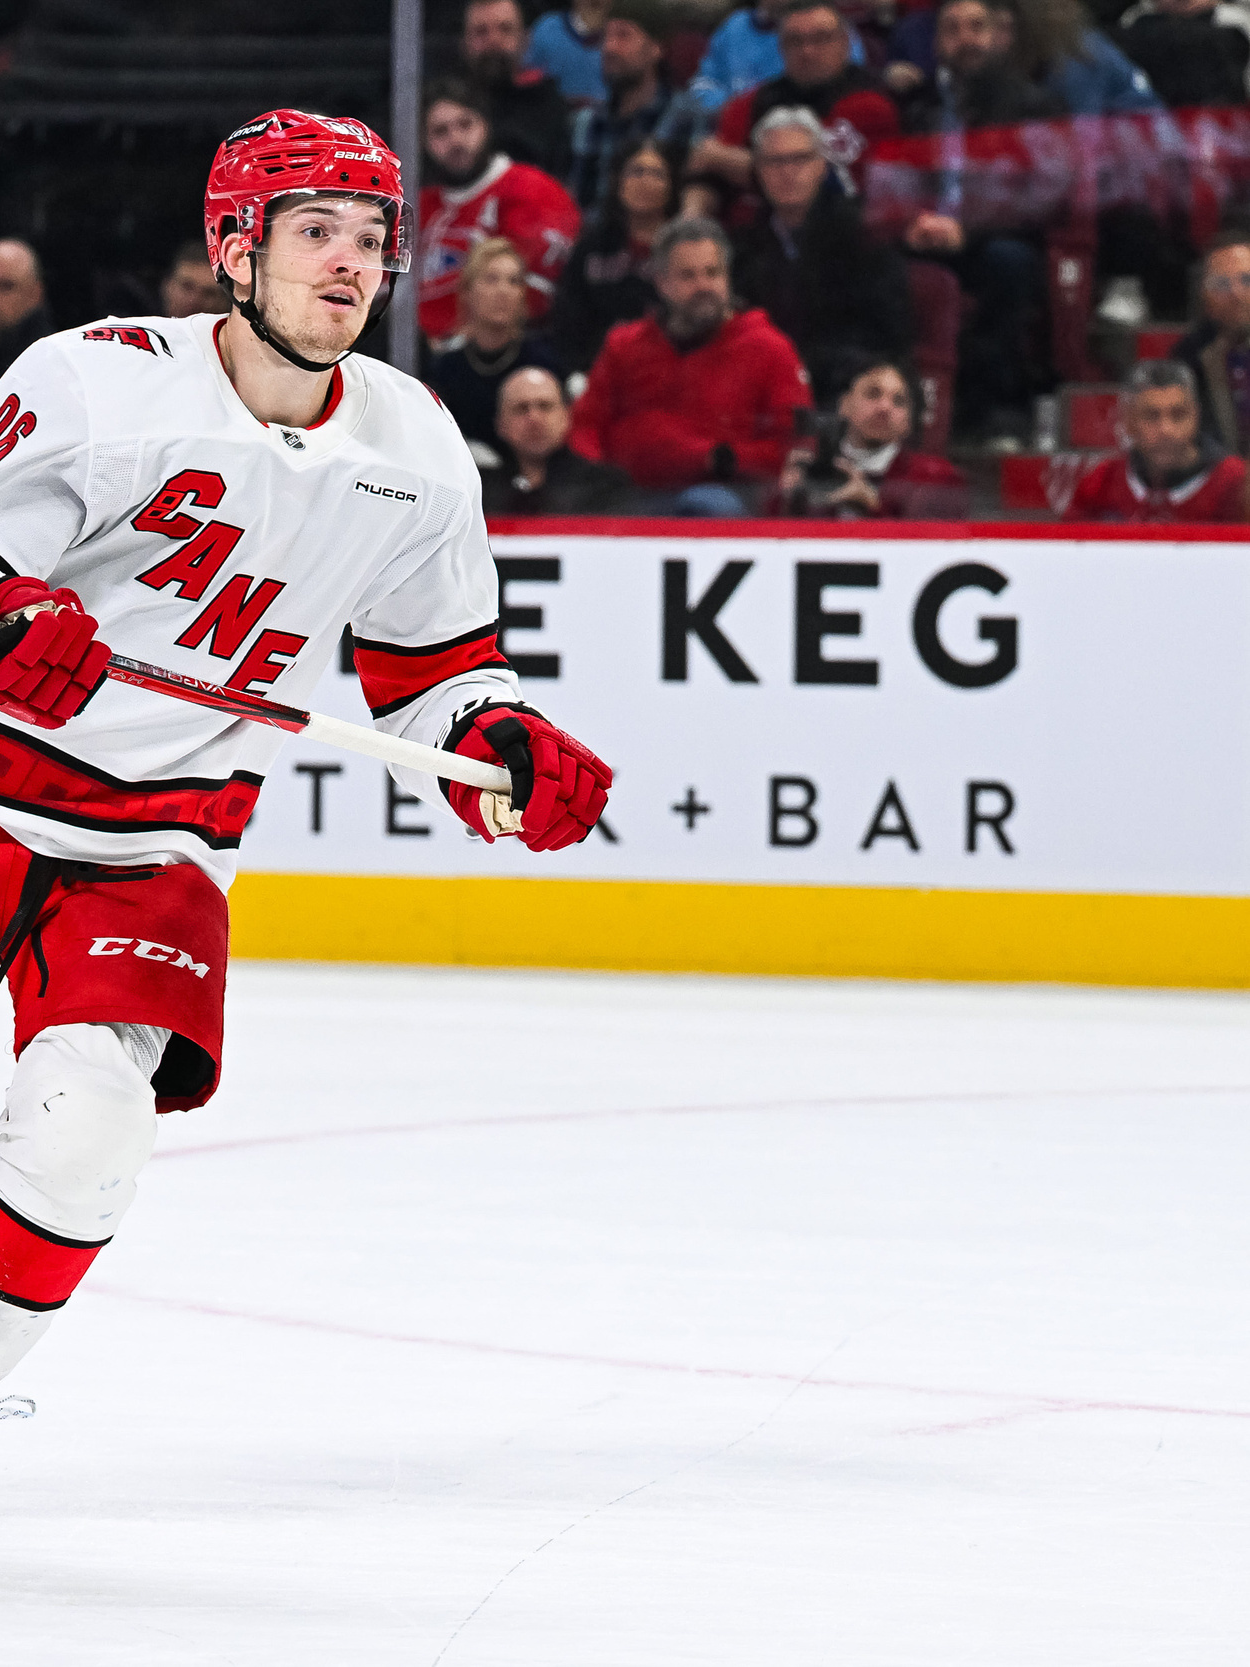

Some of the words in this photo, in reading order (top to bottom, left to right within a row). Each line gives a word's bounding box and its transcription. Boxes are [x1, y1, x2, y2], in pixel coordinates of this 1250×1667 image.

[334, 150, 383, 164] BAUER
[355, 481, 417, 503] NUCOR
[130, 468, 310, 698] CANE
[661, 559, 1018, 690] KEG
[768, 773, 1015, 856] BAR
[87, 936, 211, 979] CCM
